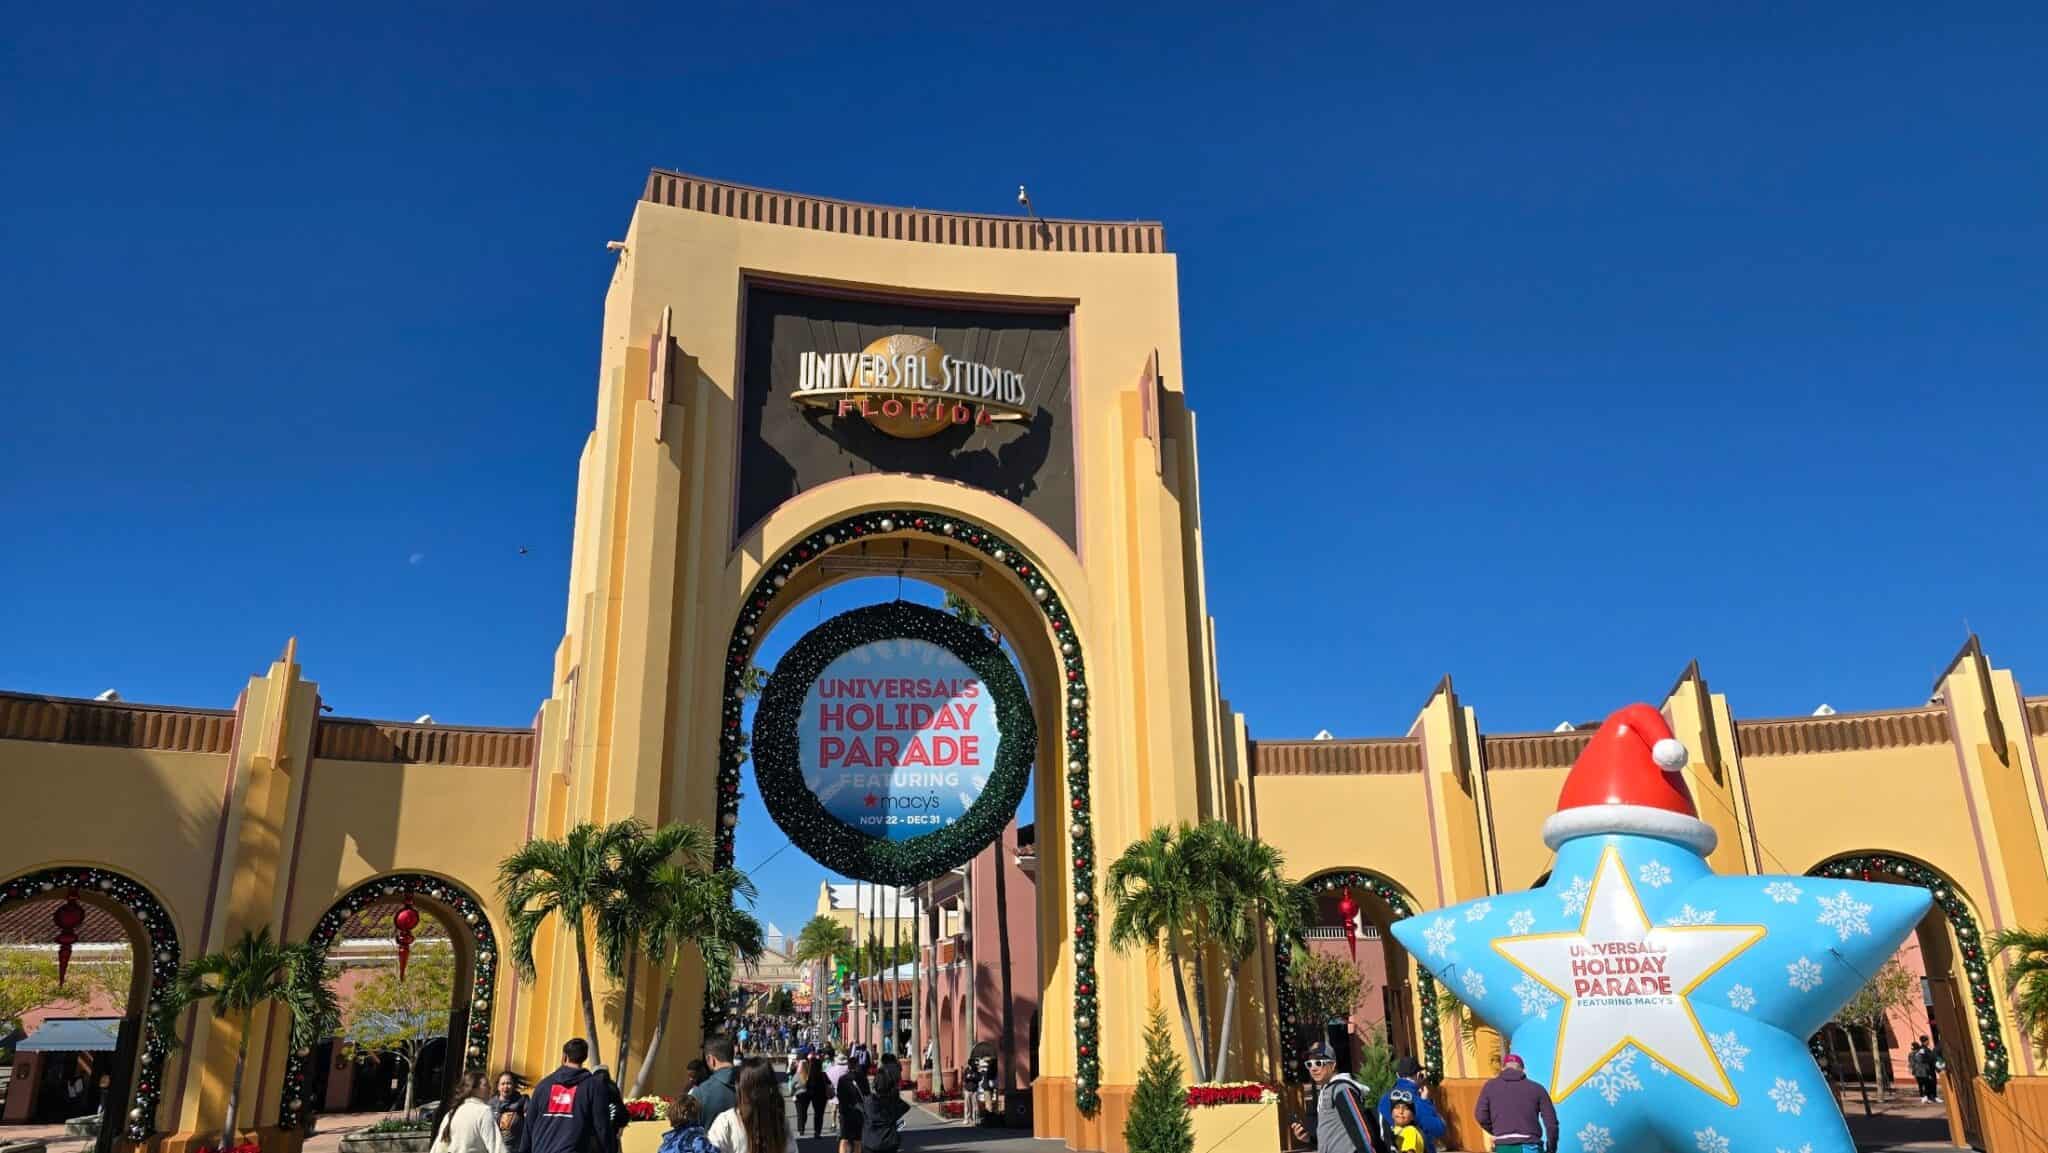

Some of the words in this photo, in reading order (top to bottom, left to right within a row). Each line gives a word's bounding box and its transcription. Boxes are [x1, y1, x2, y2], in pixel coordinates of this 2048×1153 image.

[800, 351, 933, 391] UNIVERSAL
[941, 354, 1026, 405] STUDIOS
[838, 399, 993, 425] FLORIDA
[819, 678, 979, 699] UNIVERSAL'S
[819, 703, 979, 731] HOLIDAY
[819, 735, 980, 768] PARADE
[841, 773, 960, 787] FEATURING
[860, 815, 884, 825] NOV
[885, 815, 898, 825] 22
[907, 815, 929, 825] DEC
[930, 815, 940, 825] 31
[1572, 956, 1666, 977] HOLIDAY
[1574, 976, 1673, 998] PARADE
[1577, 998, 1633, 1008] FEATURING
[1635, 996, 1674, 1006] MACYS
